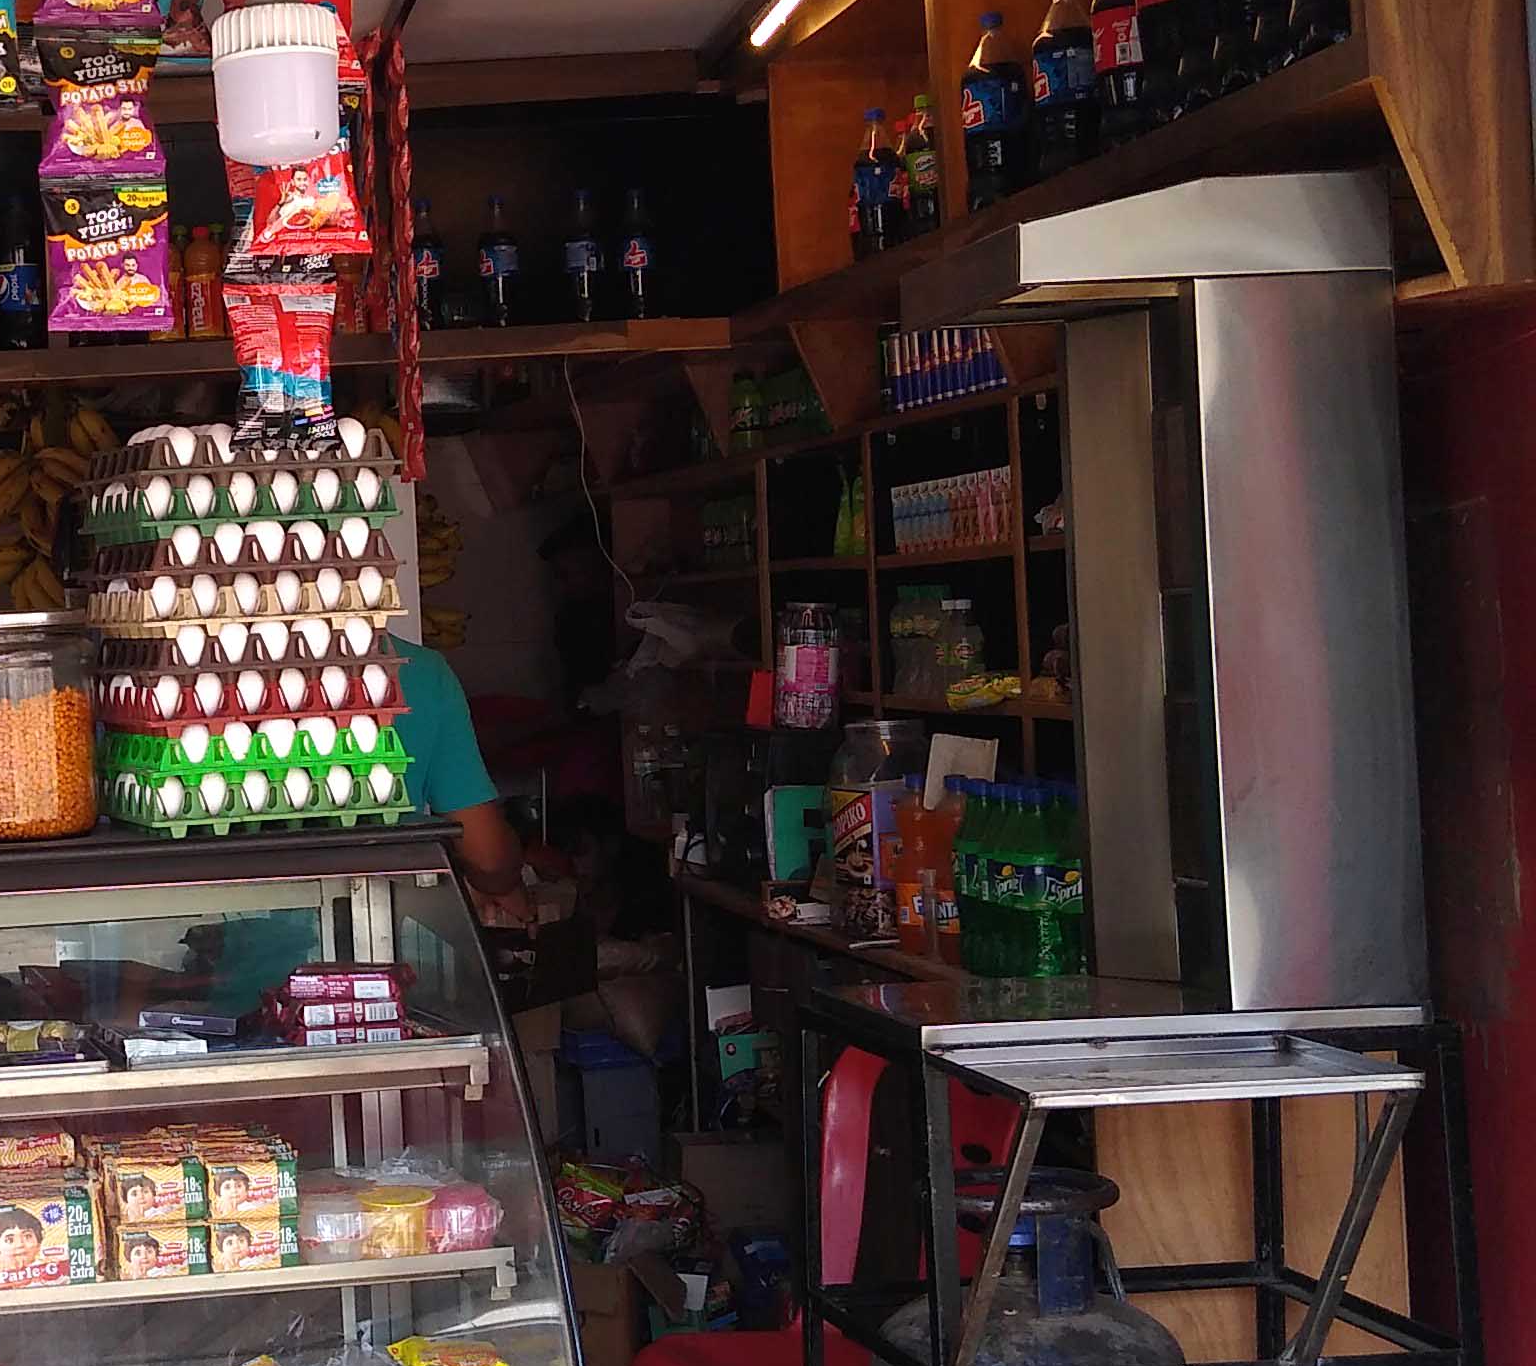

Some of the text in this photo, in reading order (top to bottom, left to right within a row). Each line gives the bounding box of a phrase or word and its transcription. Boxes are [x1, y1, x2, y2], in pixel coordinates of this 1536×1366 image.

[81, 55, 116, 70] TOO
[74, 61, 133, 82] YUMM!
[60, 84, 116, 106] POTATO
[85, 208, 121, 226] TOO
[77, 216, 134, 239] YUMM!
[66, 232, 156, 262] POTATO STIX
[184, 1190, 204, 1203] EXTRA
[278, 1186, 297, 1199] EXTRA
[68, 1204, 90, 1224] 20g
[68, 1222, 92, 1236] Extra
[280, 1241, 299, 1255] EXTRA
[70, 1248, 92, 1267] 20g
[188, 1251, 208, 1265] EXTRA
[70, 1264, 95, 1280] Extra
